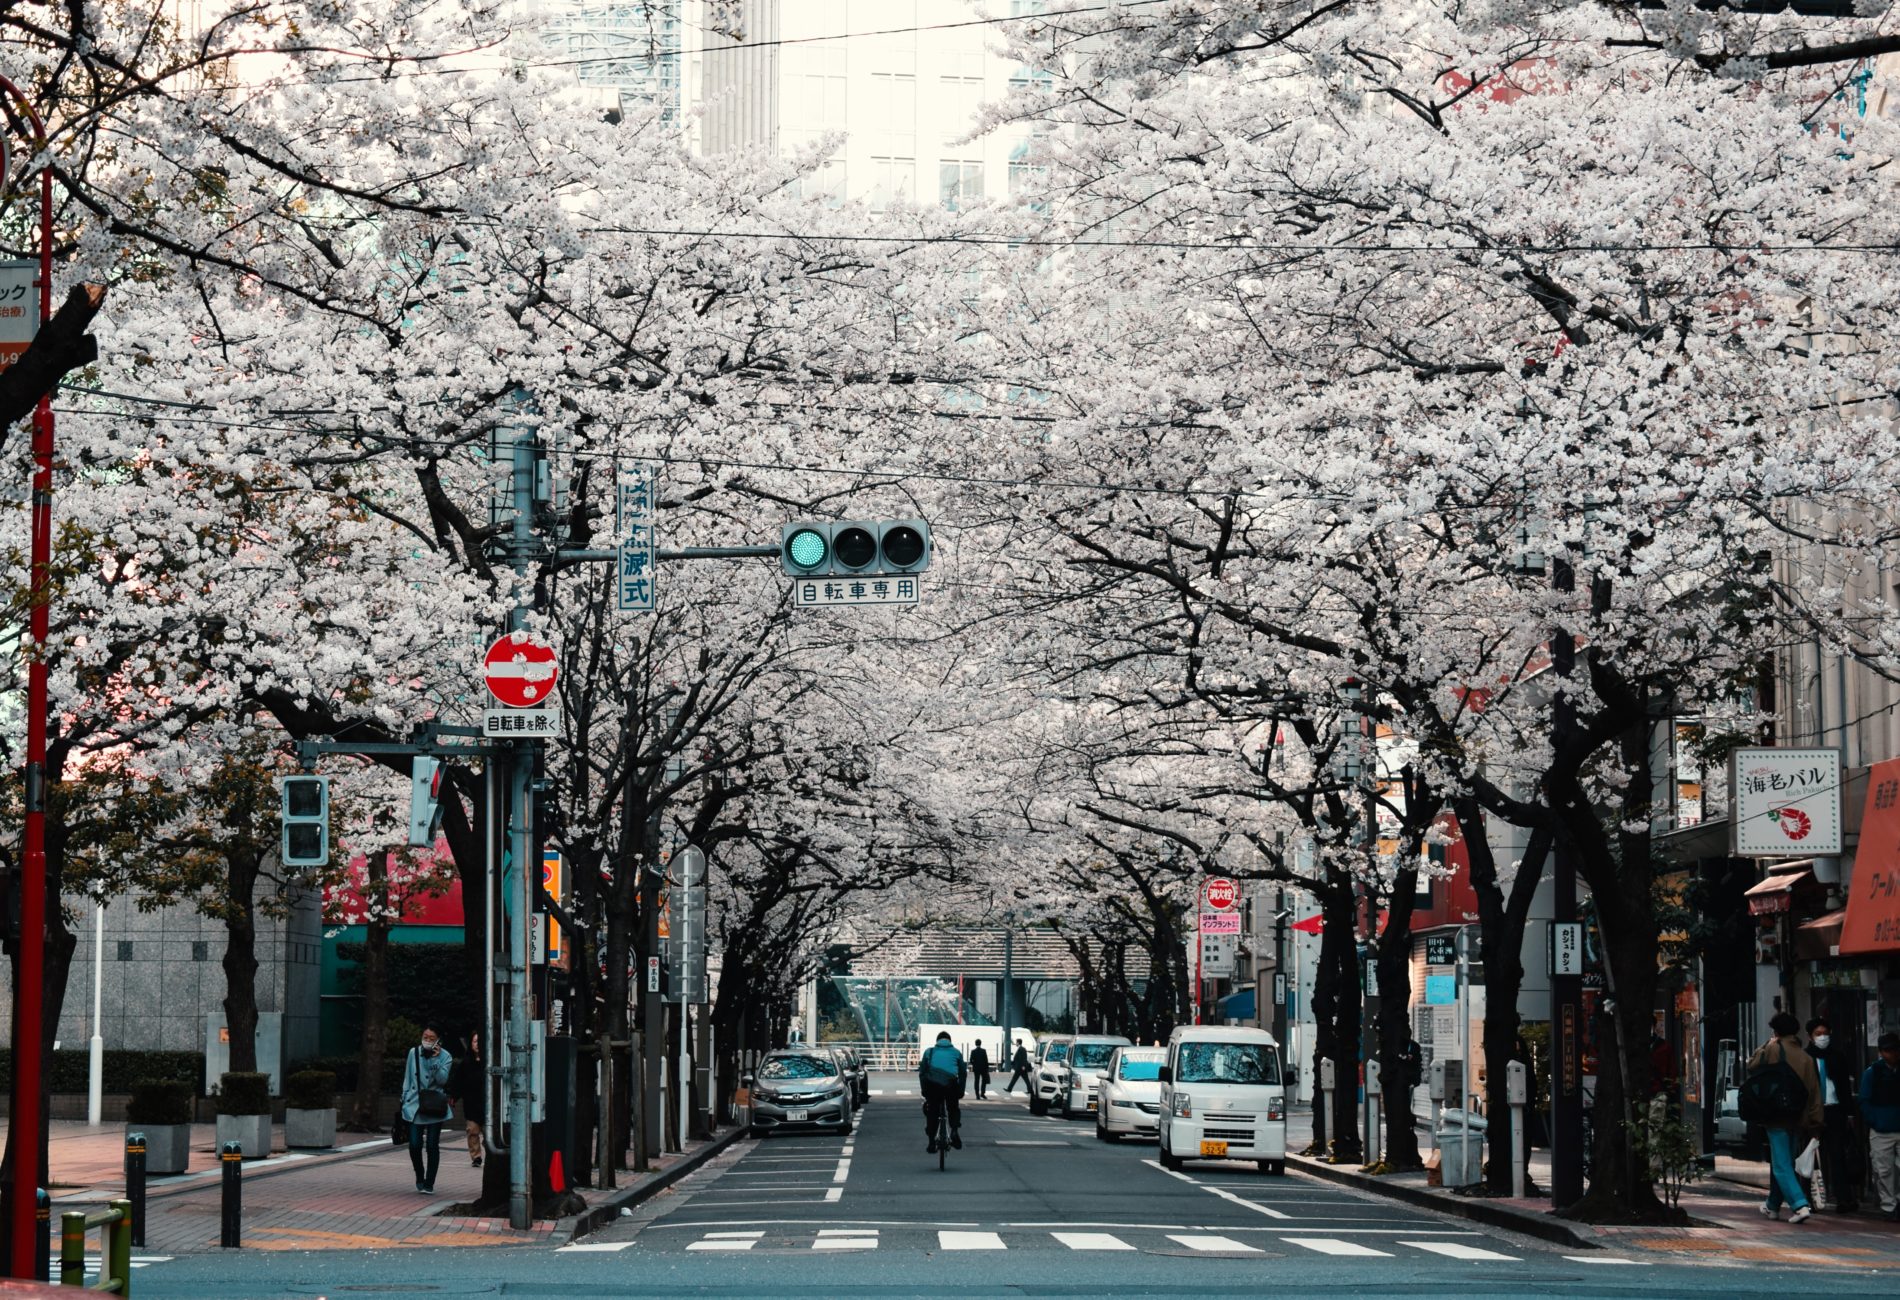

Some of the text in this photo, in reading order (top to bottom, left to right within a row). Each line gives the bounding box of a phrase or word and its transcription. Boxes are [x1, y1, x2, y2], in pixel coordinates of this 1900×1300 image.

[803, 580, 913, 601] 自転車専用
[488, 715, 556, 731] 自転車を除く
[1745, 767, 1826, 794] 海老バル
[1210, 888, 1233, 900] 消火栓
